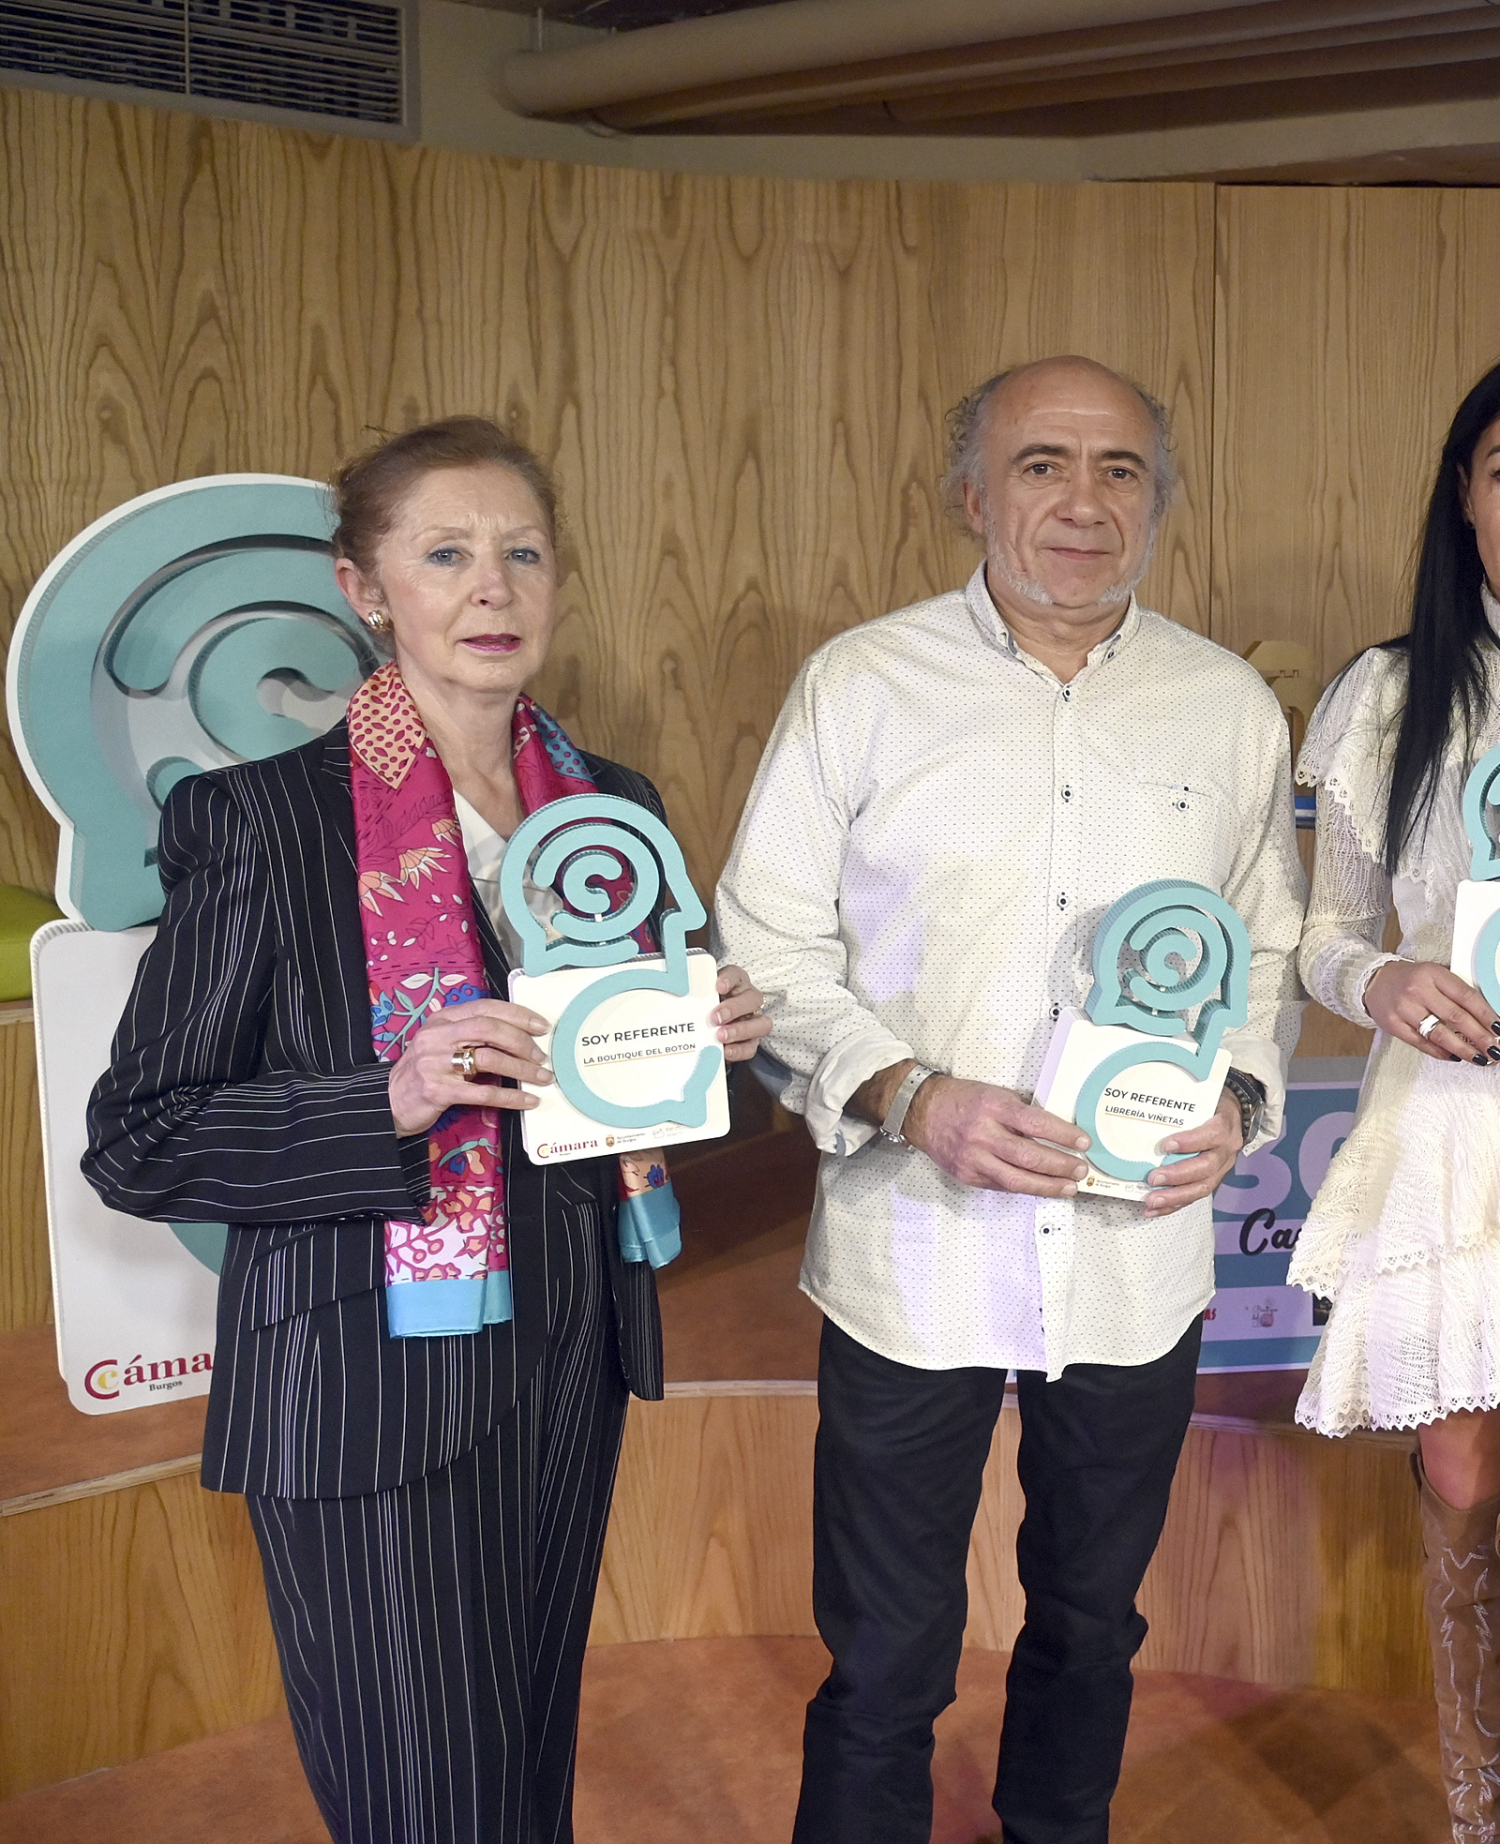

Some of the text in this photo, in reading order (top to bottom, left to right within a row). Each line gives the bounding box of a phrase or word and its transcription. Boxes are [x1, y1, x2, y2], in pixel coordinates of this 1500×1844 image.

[582, 1022, 695, 1046] SOY REFERENTE
[583, 1056, 595, 1064] LA
[597, 1050, 644, 1063] BOUTIQUE
[646, 1048, 663, 1057] DEL
[1104, 1088, 1196, 1113] SOY REFERENTE
[1105, 1105, 1185, 1126] LIBRERÍA VIÑETAS
[84, 1352, 214, 1400] Cáma
[149, 1379, 183, 1392] Burgos
